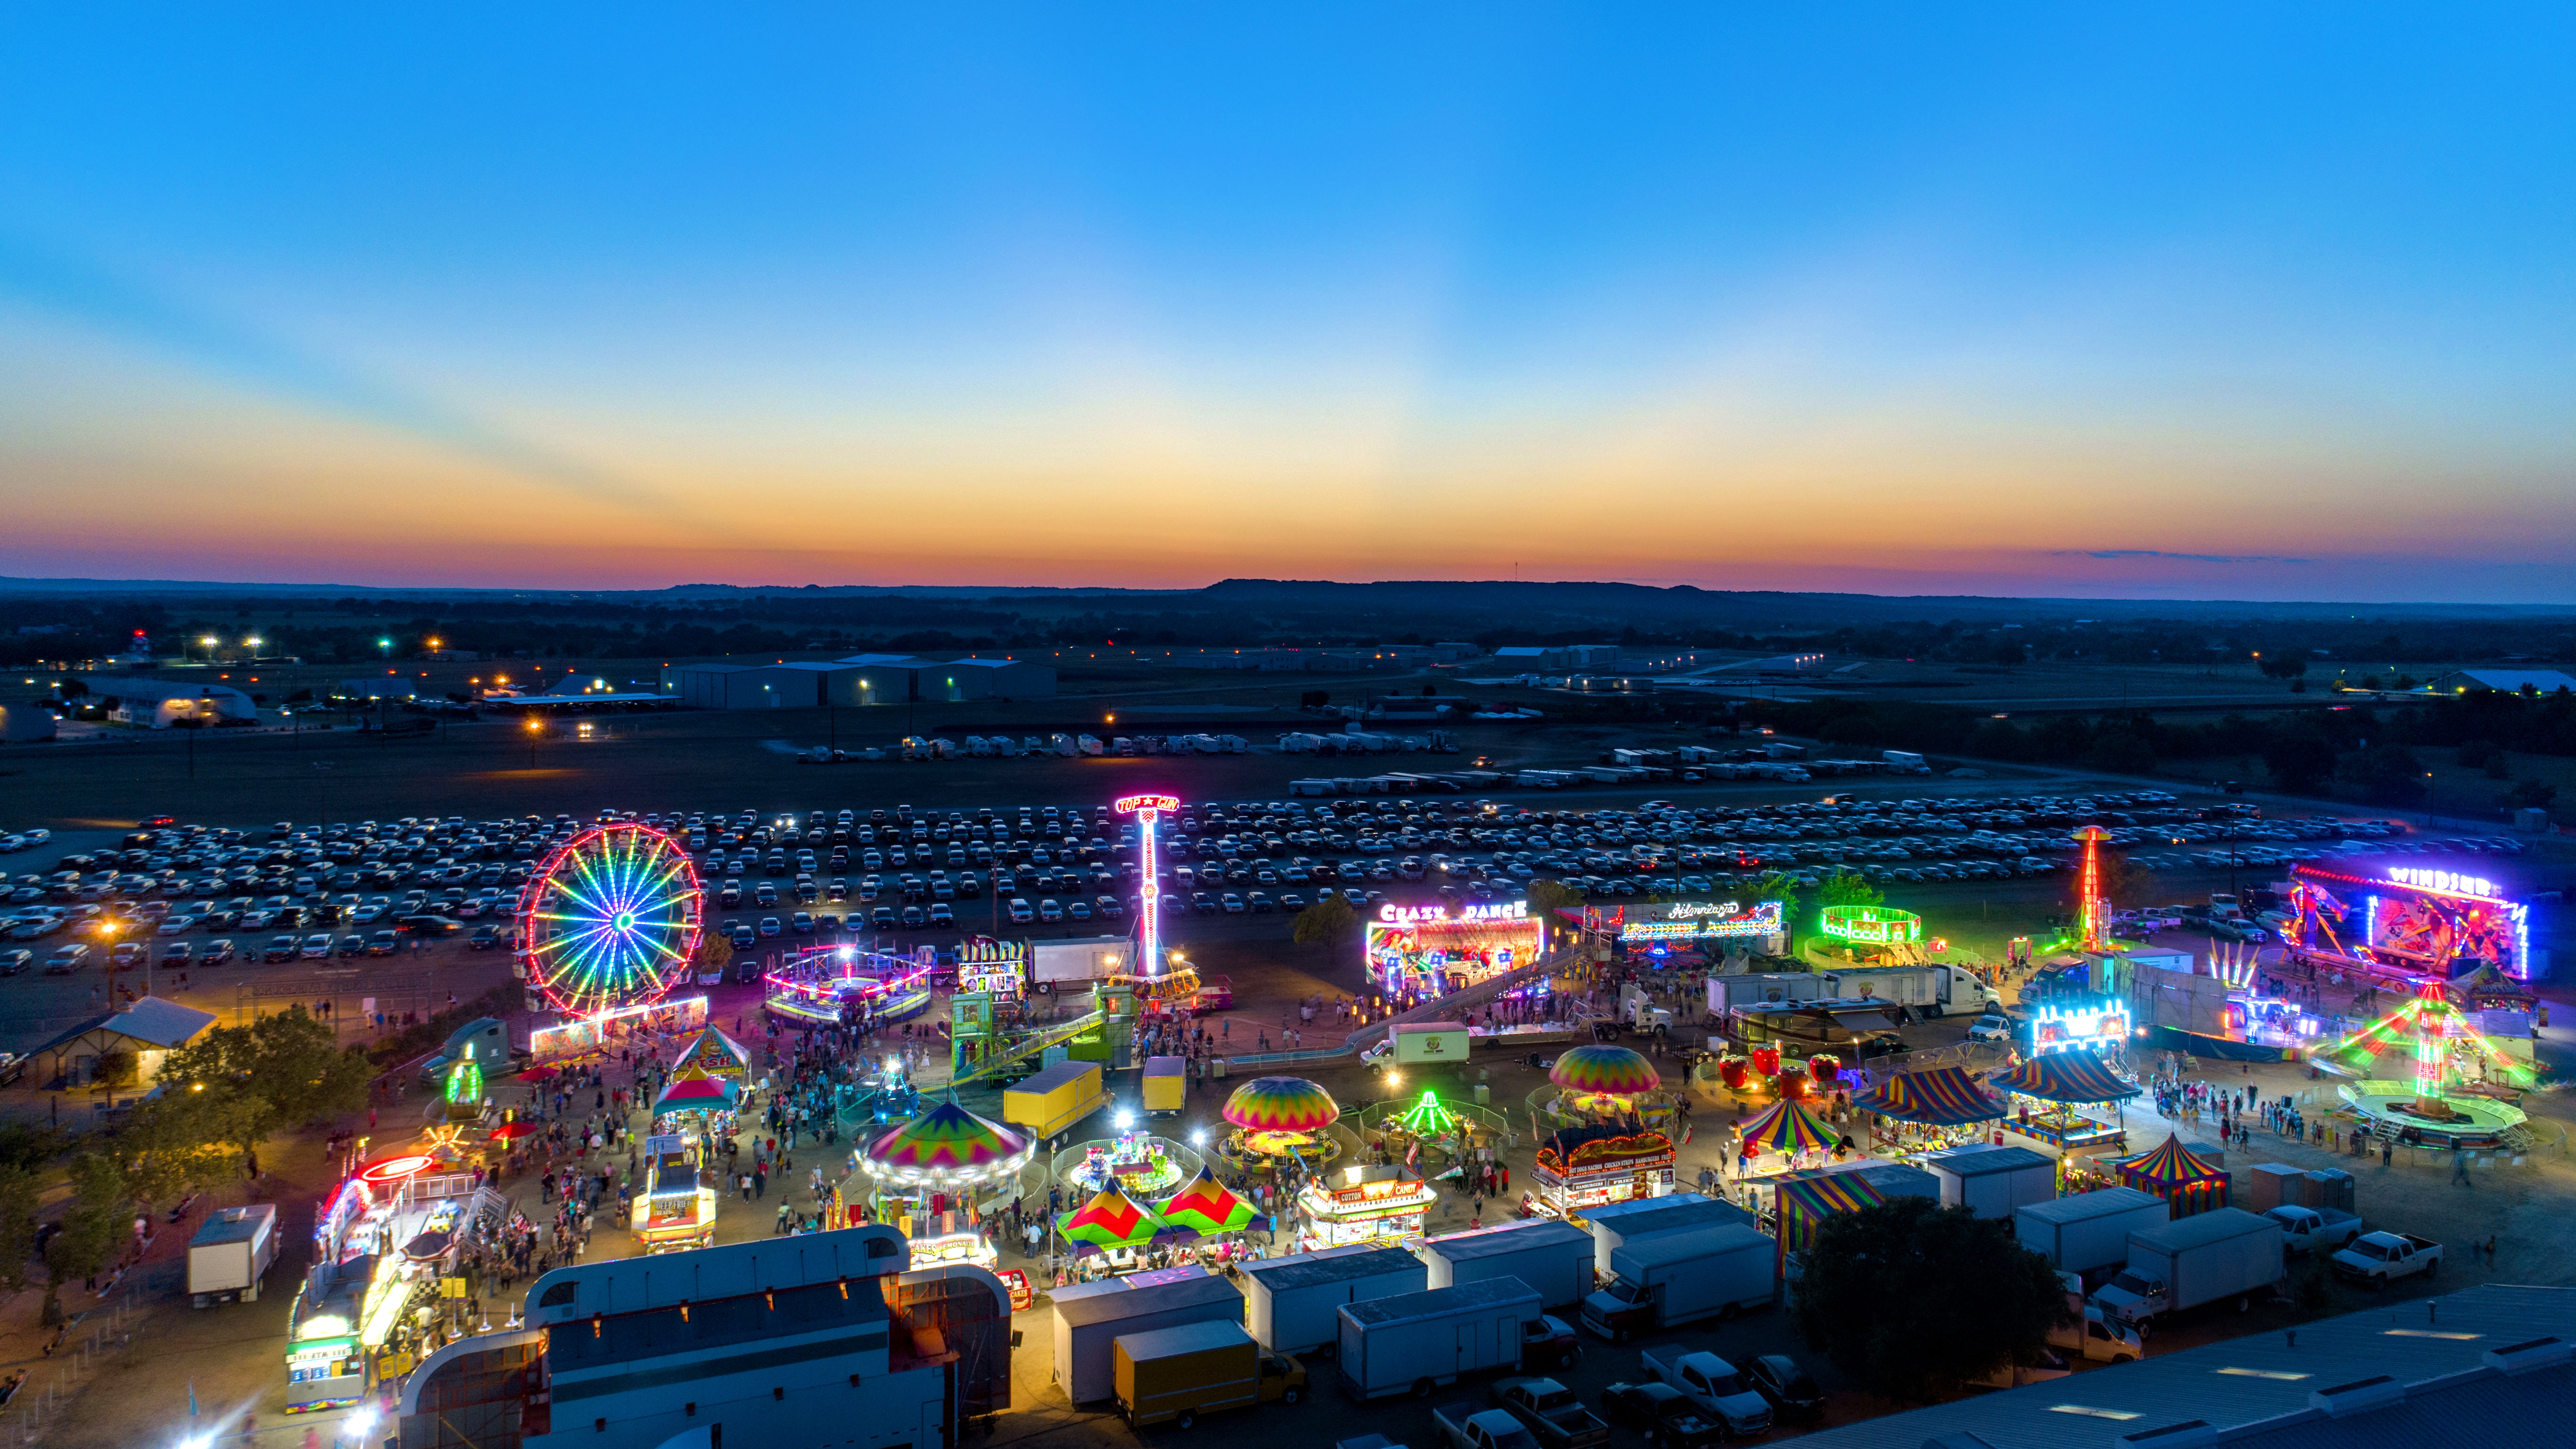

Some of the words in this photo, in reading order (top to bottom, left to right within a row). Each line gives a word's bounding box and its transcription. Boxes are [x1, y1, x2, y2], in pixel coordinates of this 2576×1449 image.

[1119, 798, 1141, 811] TOP
[1156, 797, 1178, 810] GUN
[2389, 867, 2502, 897] WINDSURF
[1380, 904, 1445, 921] CRAZY
[686, 1056, 731, 1069] FISH
[1635, 1155, 1660, 1164] HAMBURGERS
[1576, 1181, 1603, 1190] HAMBURGERS
[1341, 1191, 1362, 1202] COTTON
[1395, 1184, 1416, 1195] CANDY
[656, 1202, 673, 1210] DEEP
[674, 1200, 692, 1209] FRIED
[1347, 1212, 1382, 1222] POPCORN
[1396, 1206, 1423, 1215] APPLES
[910, 1244, 937, 1256] CAKES
[939, 1241, 975, 1252] LEMONADE
[1010, 1289, 1028, 1298] CAKES
[311, 1351, 328, 1359] ATM
